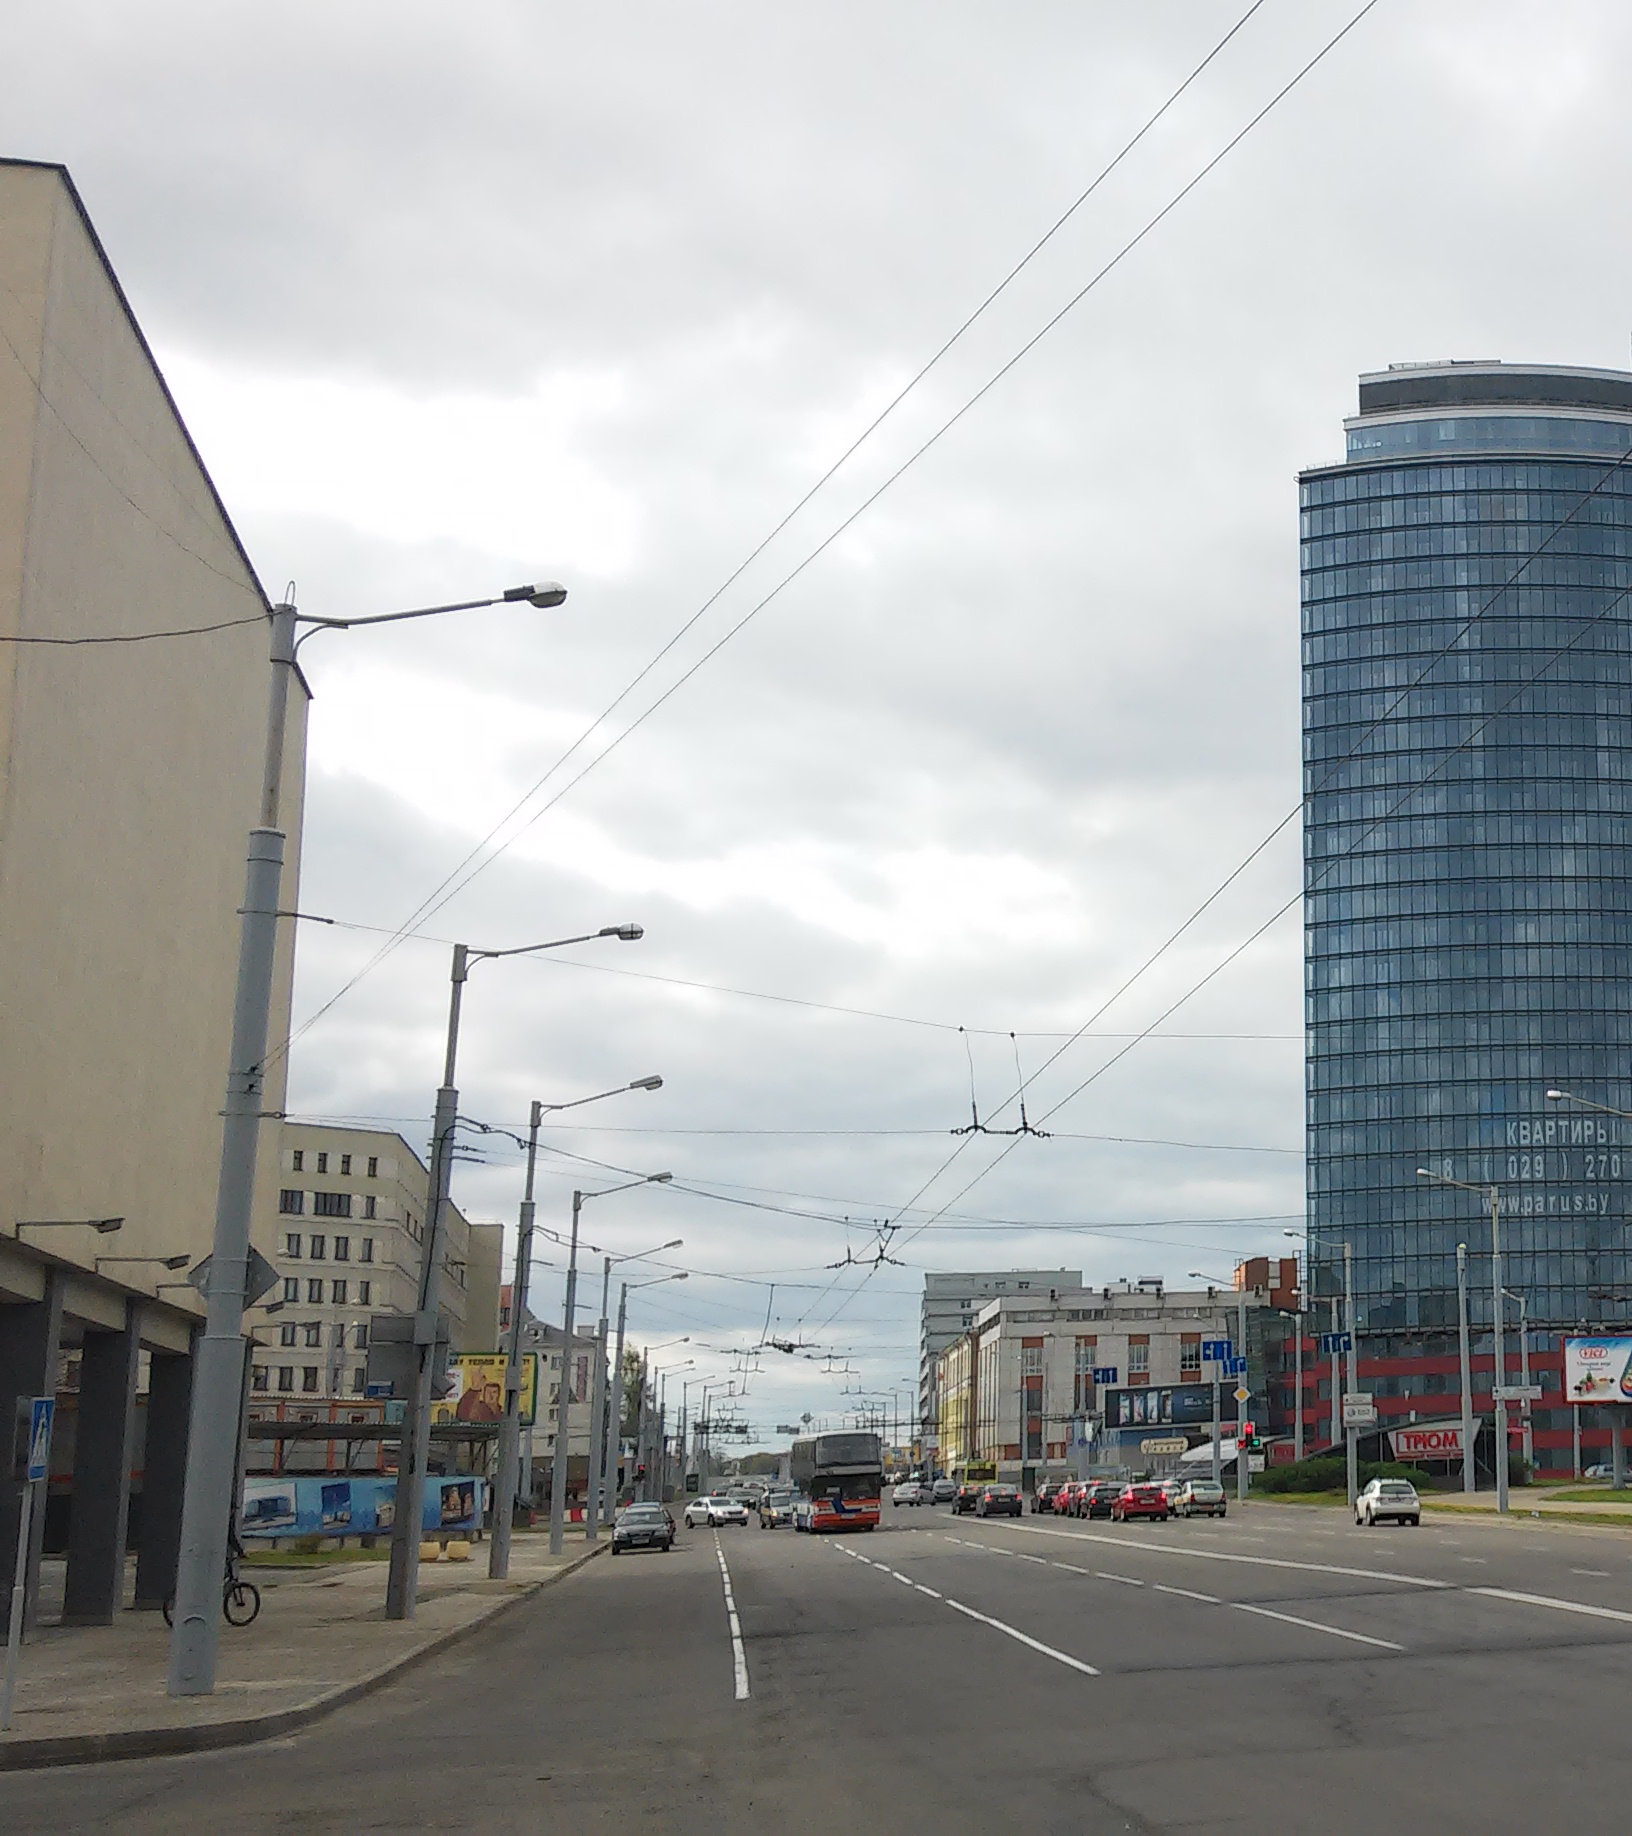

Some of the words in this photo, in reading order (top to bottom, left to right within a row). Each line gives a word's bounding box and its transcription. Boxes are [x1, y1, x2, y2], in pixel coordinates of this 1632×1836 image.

[1506, 1119, 1618, 1145] КВАРТИРЫ
[1508, 1154, 1544, 1179] 029
[1585, 1154, 1620, 1178] 270
[1481, 1192, 1609, 1216] www.parus.by
[1403, 1430, 1459, 1449] ТРЮМ
